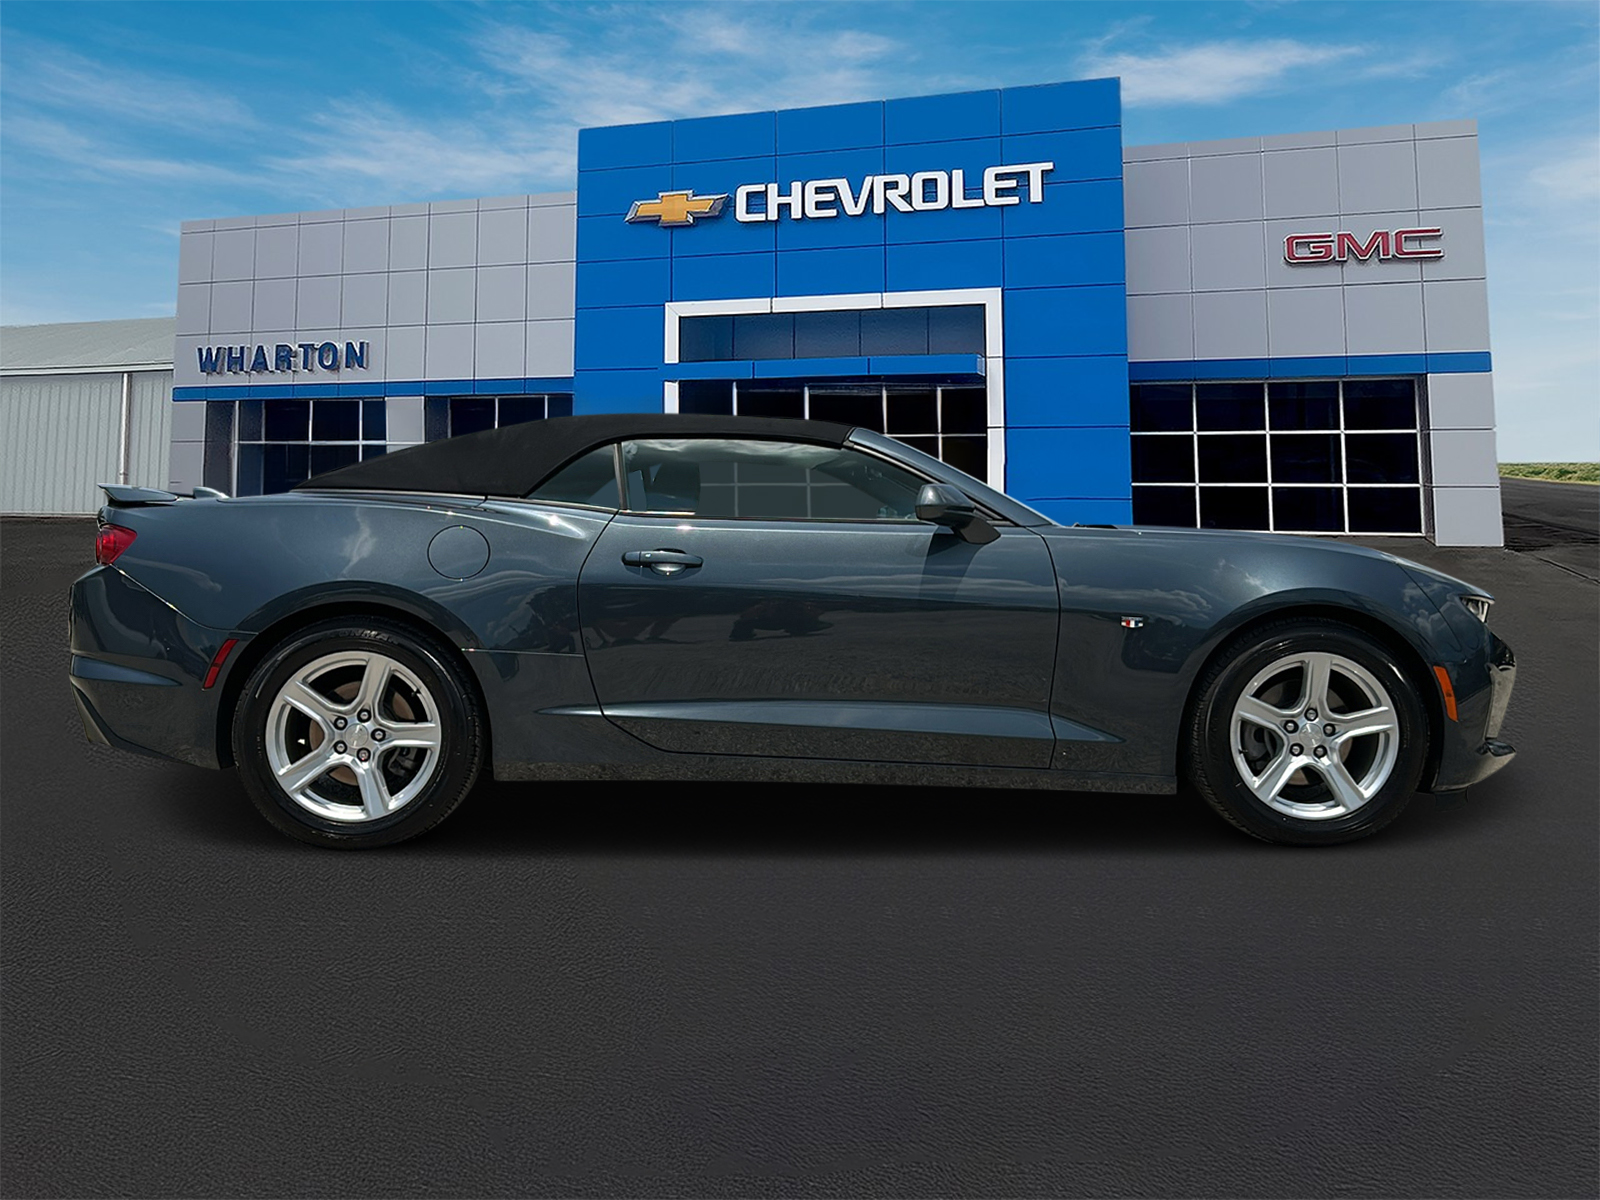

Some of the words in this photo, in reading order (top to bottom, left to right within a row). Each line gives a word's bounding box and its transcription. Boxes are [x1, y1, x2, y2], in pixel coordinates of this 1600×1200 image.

[734, 161, 1055, 223] CHEVROLET
[1284, 227, 1444, 264] GMC
[197, 341, 369, 374] WHARTON
